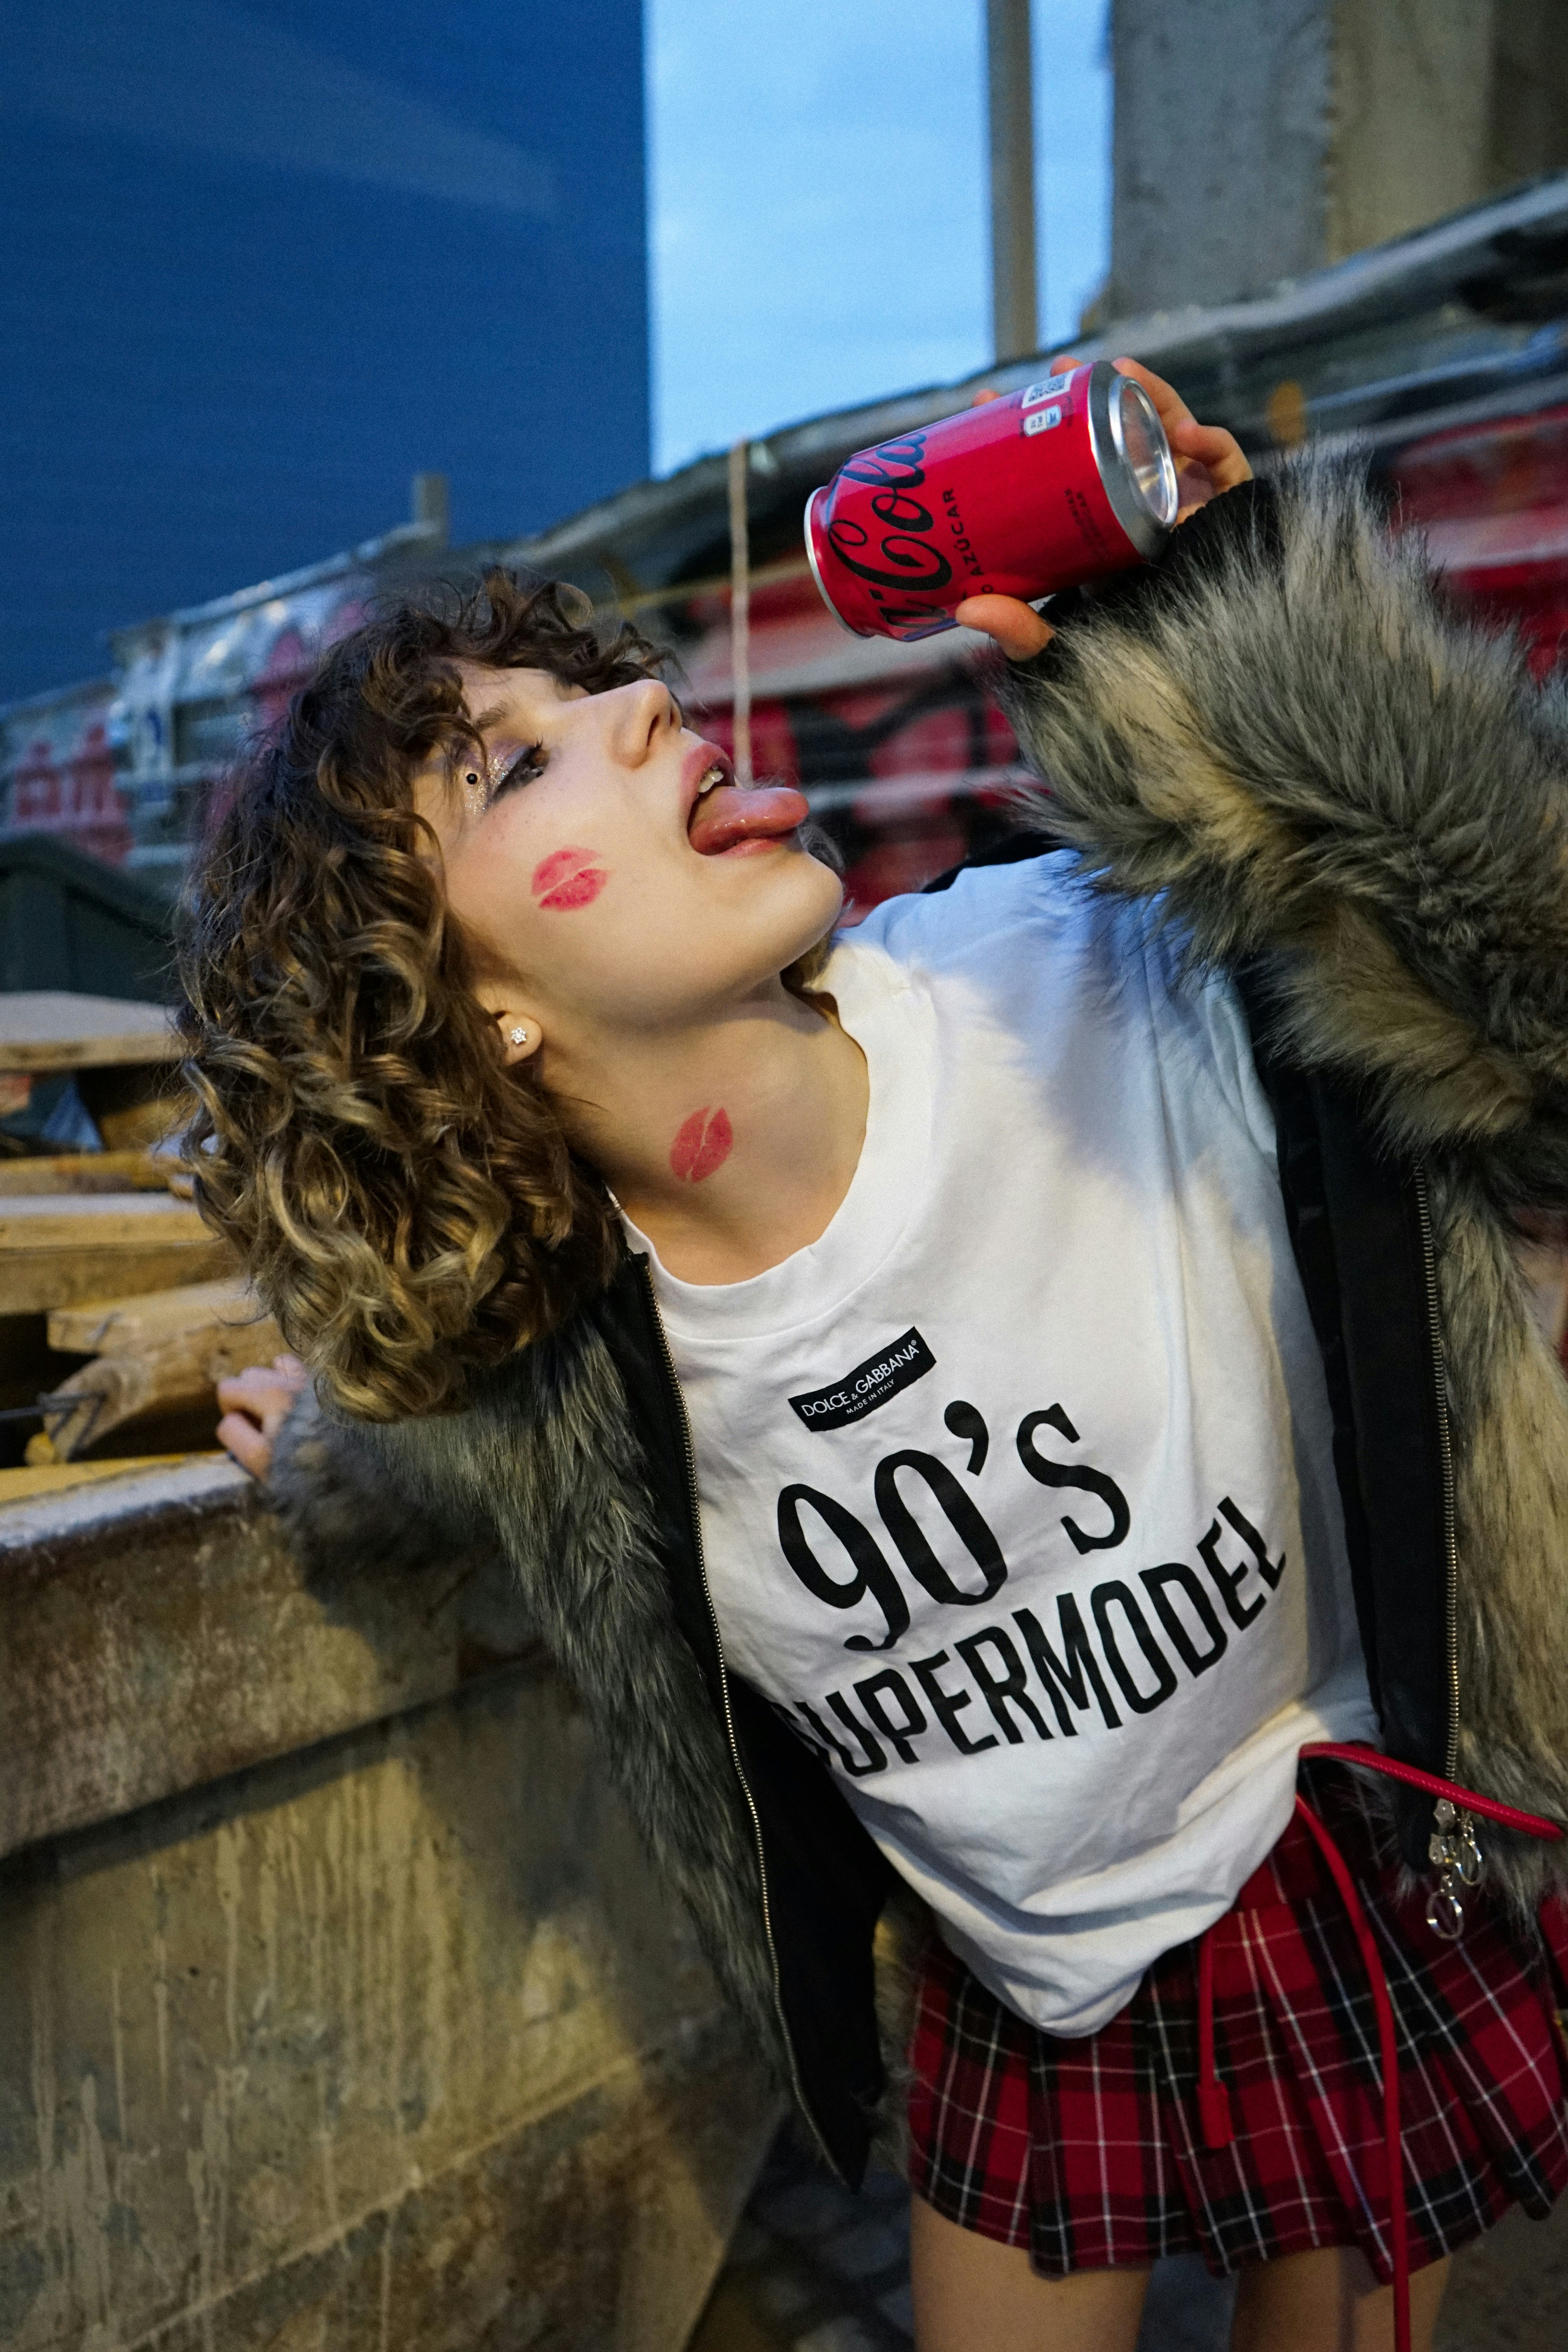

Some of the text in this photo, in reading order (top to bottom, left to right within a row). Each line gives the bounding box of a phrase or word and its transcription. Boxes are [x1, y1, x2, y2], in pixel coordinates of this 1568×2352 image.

[942, 488, 984, 576] AZÚCAR
[801, 1391, 851, 1416] DOLCE
[846, 1399, 868, 1414] MADE
[877, 1379, 894, 1395] ITALY
[777, 1400, 1131, 1651] 90'S
